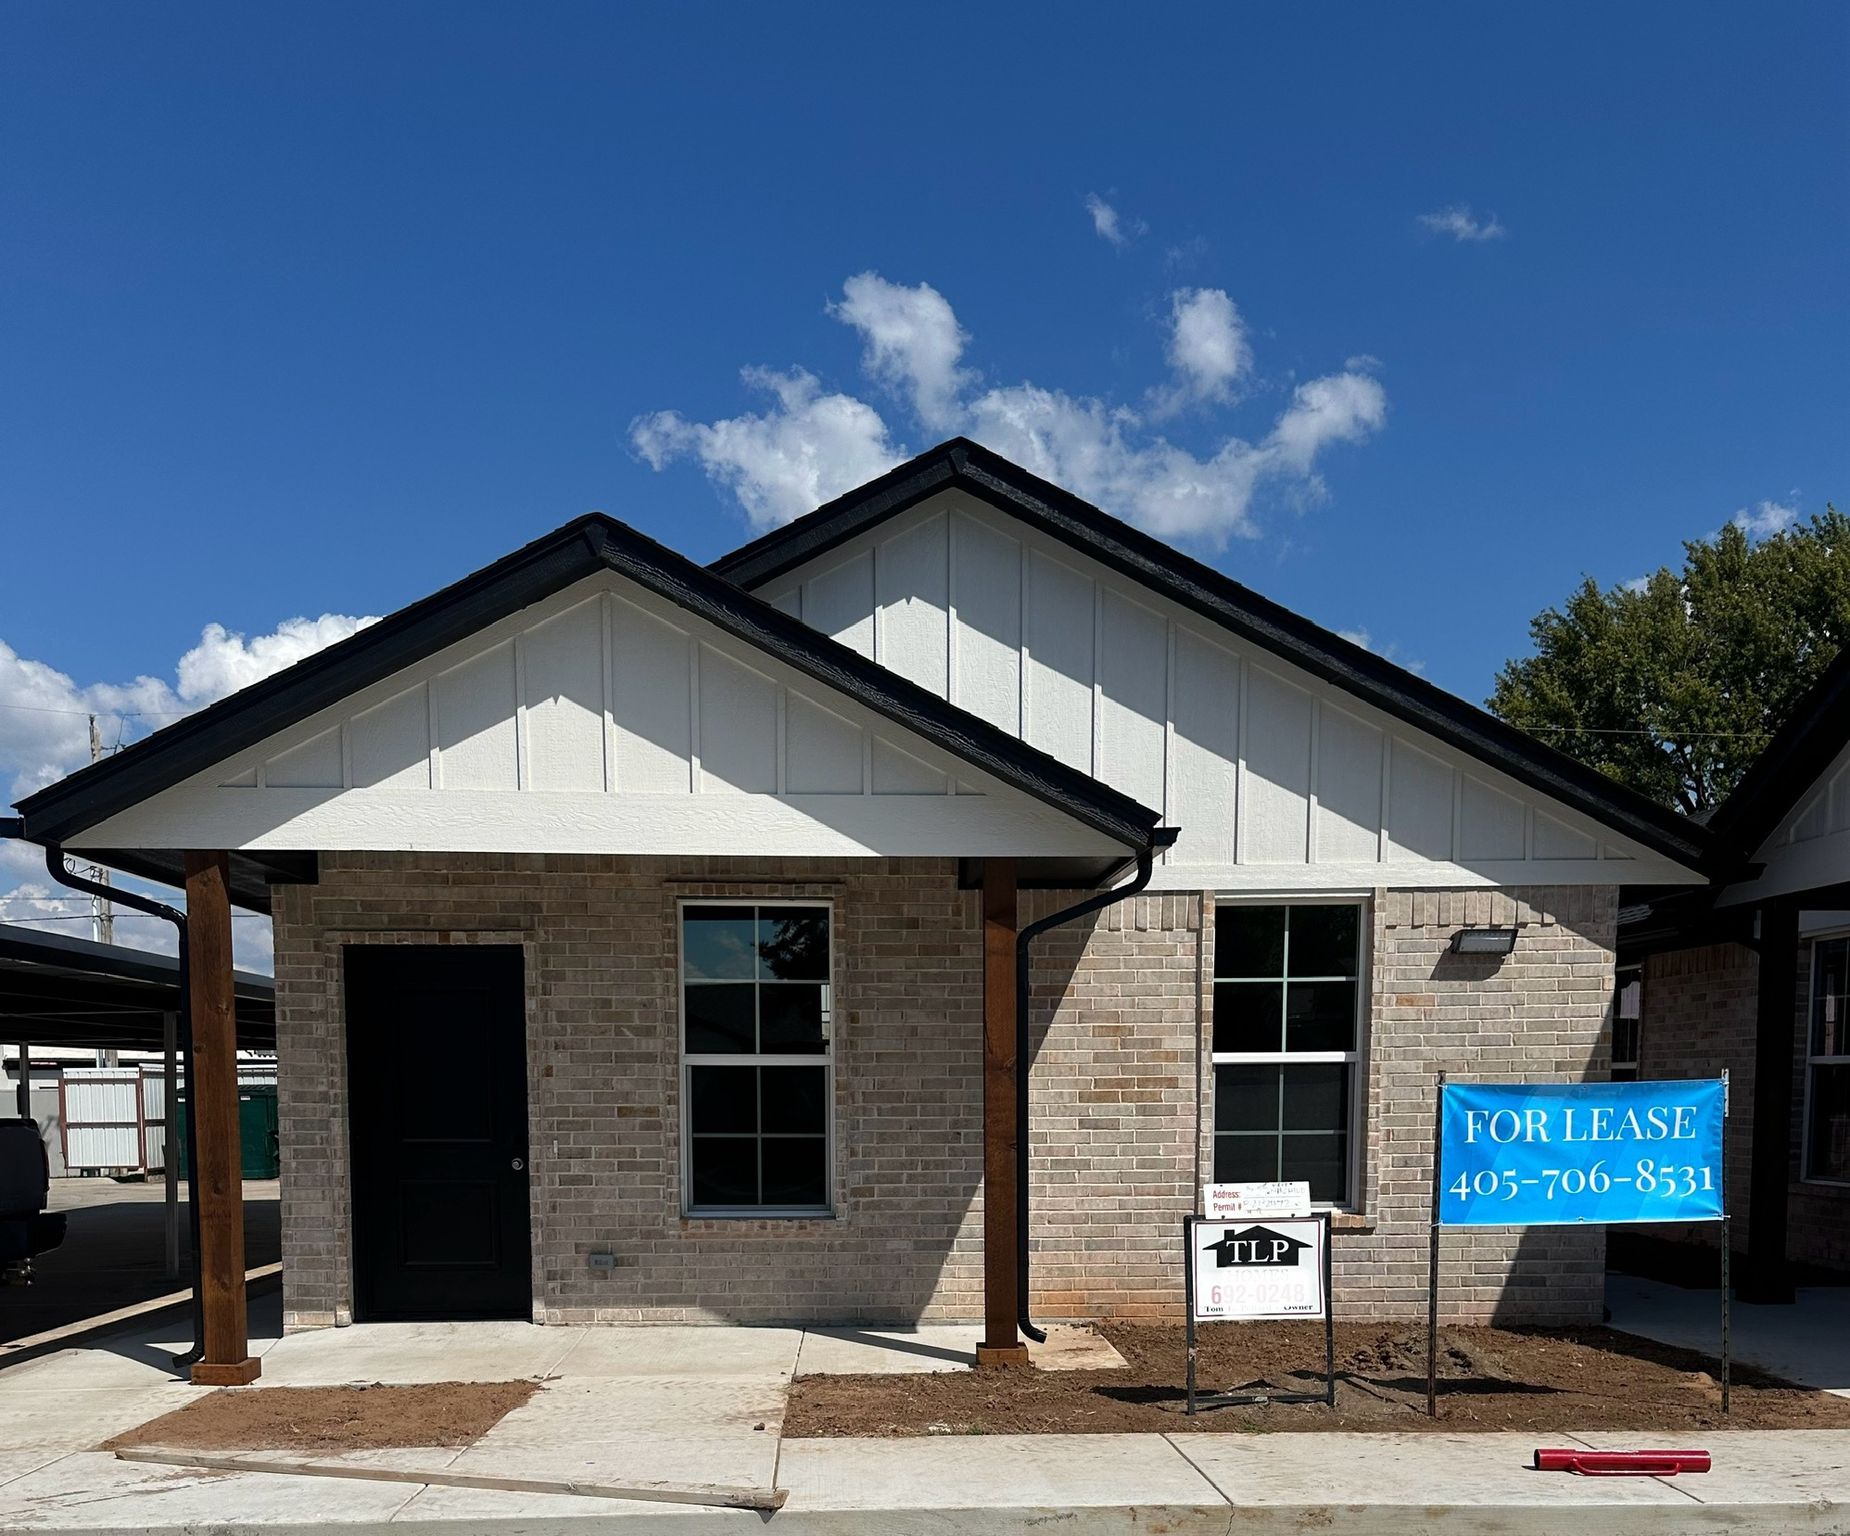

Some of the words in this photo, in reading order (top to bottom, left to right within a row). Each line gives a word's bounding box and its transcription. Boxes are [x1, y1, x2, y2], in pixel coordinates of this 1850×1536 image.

[1464, 1109, 1552, 1143] FOR
[1563, 1106, 1697, 1142] LEASE
[1448, 1158, 1716, 1201] 405-706-8531
[1212, 1190, 1241, 1199] Address:
[1213, 1203, 1237, 1212] Permit
[1226, 1239, 1290, 1263] TLP
[1211, 1284, 1305, 1304] 692-0248
